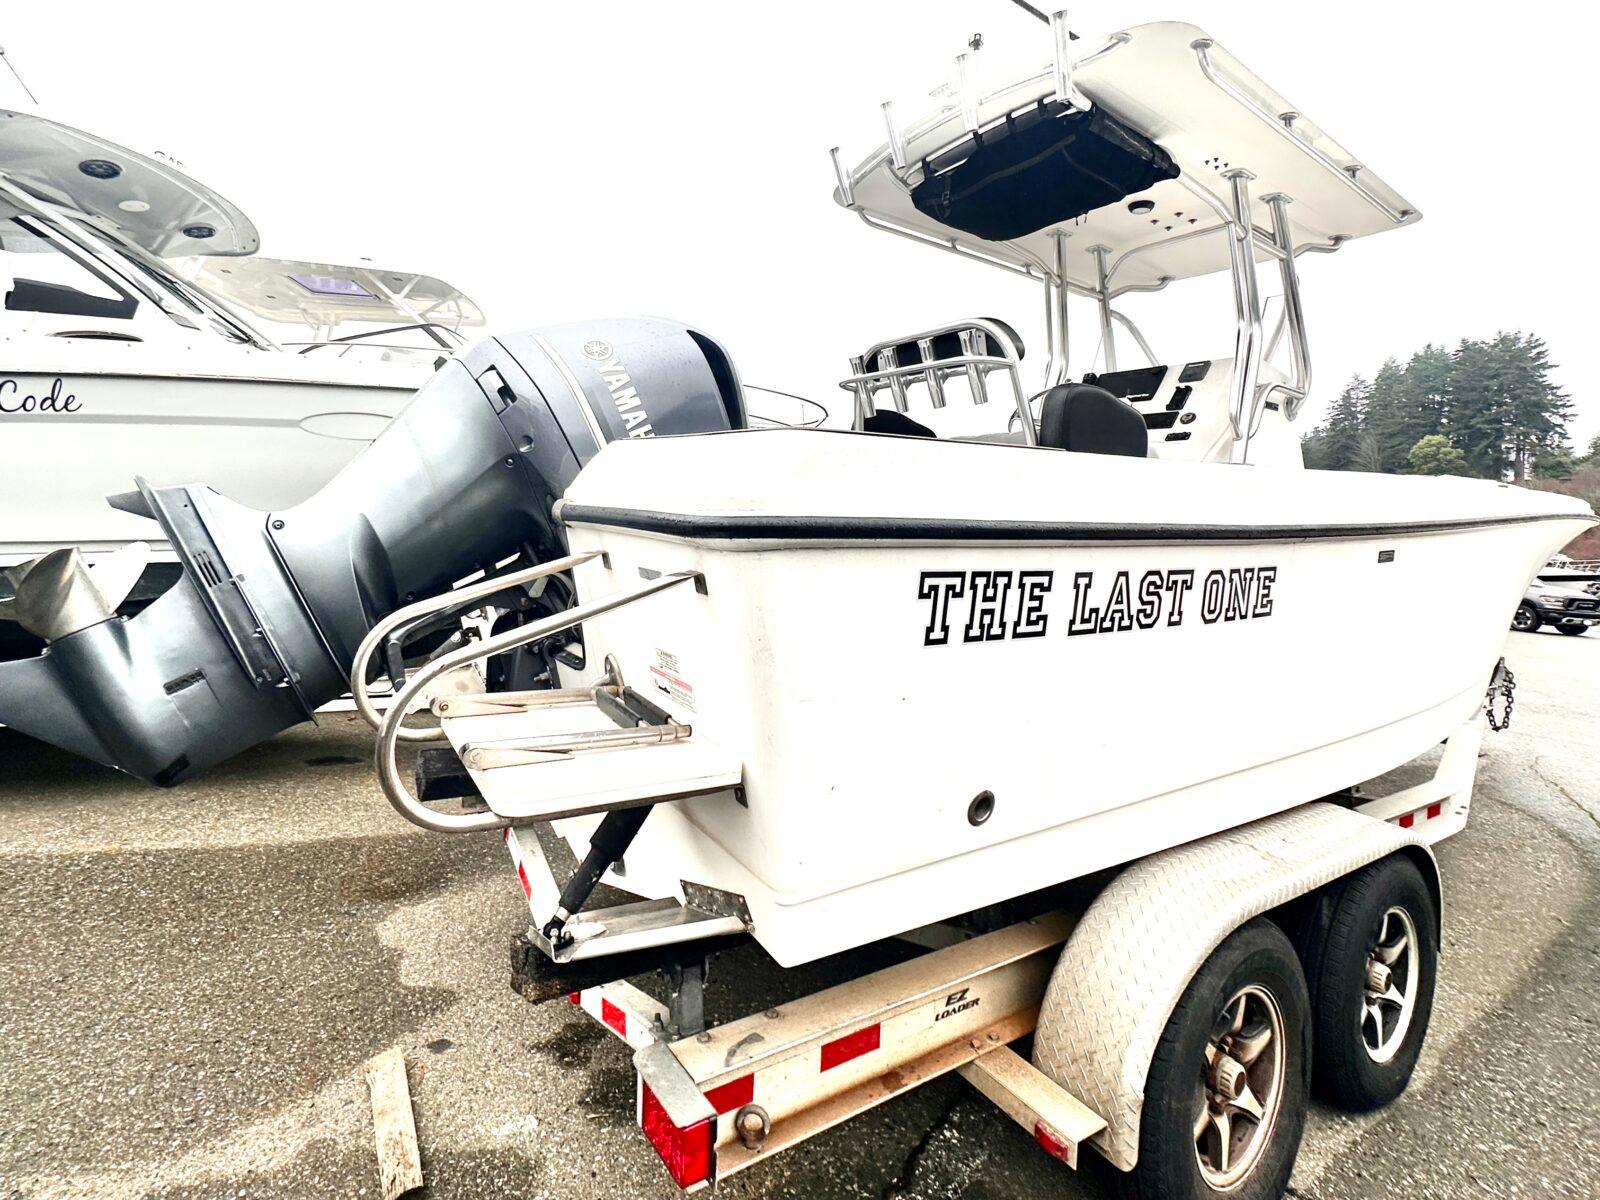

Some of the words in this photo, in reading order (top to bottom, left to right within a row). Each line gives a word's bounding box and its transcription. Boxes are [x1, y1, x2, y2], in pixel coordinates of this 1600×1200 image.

[0, 377, 82, 412] Code
[597, 358, 656, 438] YAMAH
[918, 569, 1054, 647] THE
[1067, 569, 1195, 637] LAST
[1201, 566, 1277, 625] ONE
[935, 997, 980, 1022] LOADER
[945, 987, 970, 1008] EZ
